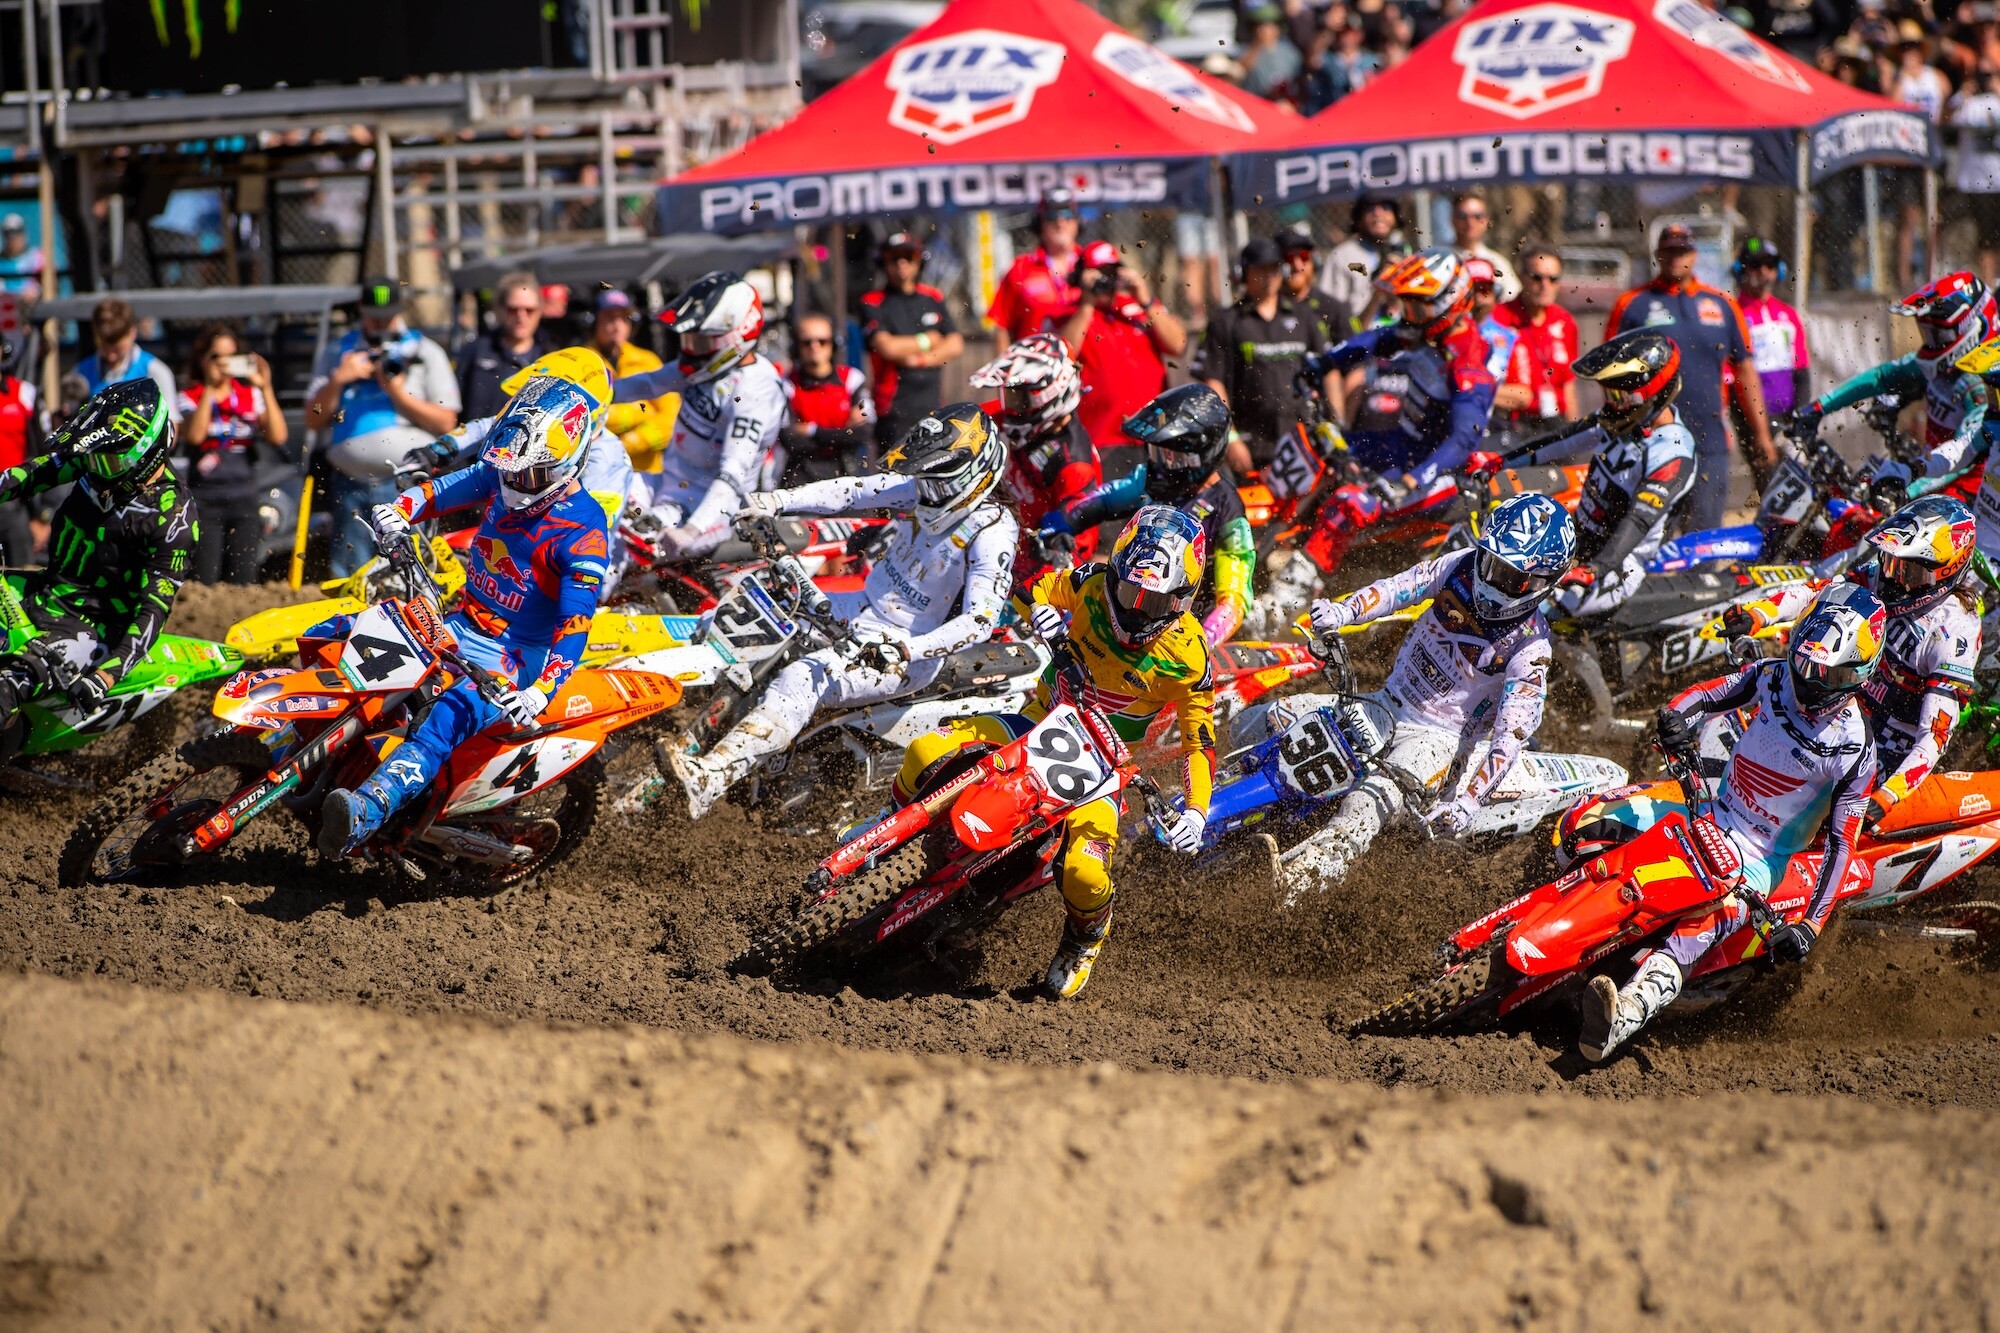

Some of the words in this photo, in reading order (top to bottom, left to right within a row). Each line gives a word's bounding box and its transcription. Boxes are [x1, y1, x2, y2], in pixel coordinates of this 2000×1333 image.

[1275, 136, 1754, 197] PROMOTOCROSS
[701, 163, 1167, 229] PROMOTOCROSS
[73, 427, 111, 452] AIROH
[732, 416, 763, 444] 65
[883, 555, 931, 607] Husqvarna
[713, 595, 786, 648] 27
[349, 633, 417, 683] 4
[1080, 635, 1105, 660] SHOWA
[631, 702, 665, 716] DUNLOP
[490, 743, 540, 794] 4
[1027, 727, 1098, 801] 96
[1280, 721, 1348, 796] 36
[249, 784, 292, 818] MOTOREX
[1559, 785, 1595, 803] DUNLOP
[1726, 770, 1781, 826] HONDA
[837, 816, 898, 861] DUNLOP
[1695, 822, 1726, 873] RENTHAL
[1633, 855, 1695, 889] 1
[883, 892, 944, 938] DUNLOP
[1466, 892, 1532, 933] DUNLOP
[1770, 896, 1806, 912] HONDA
[1511, 940, 1529, 970] HONDA
